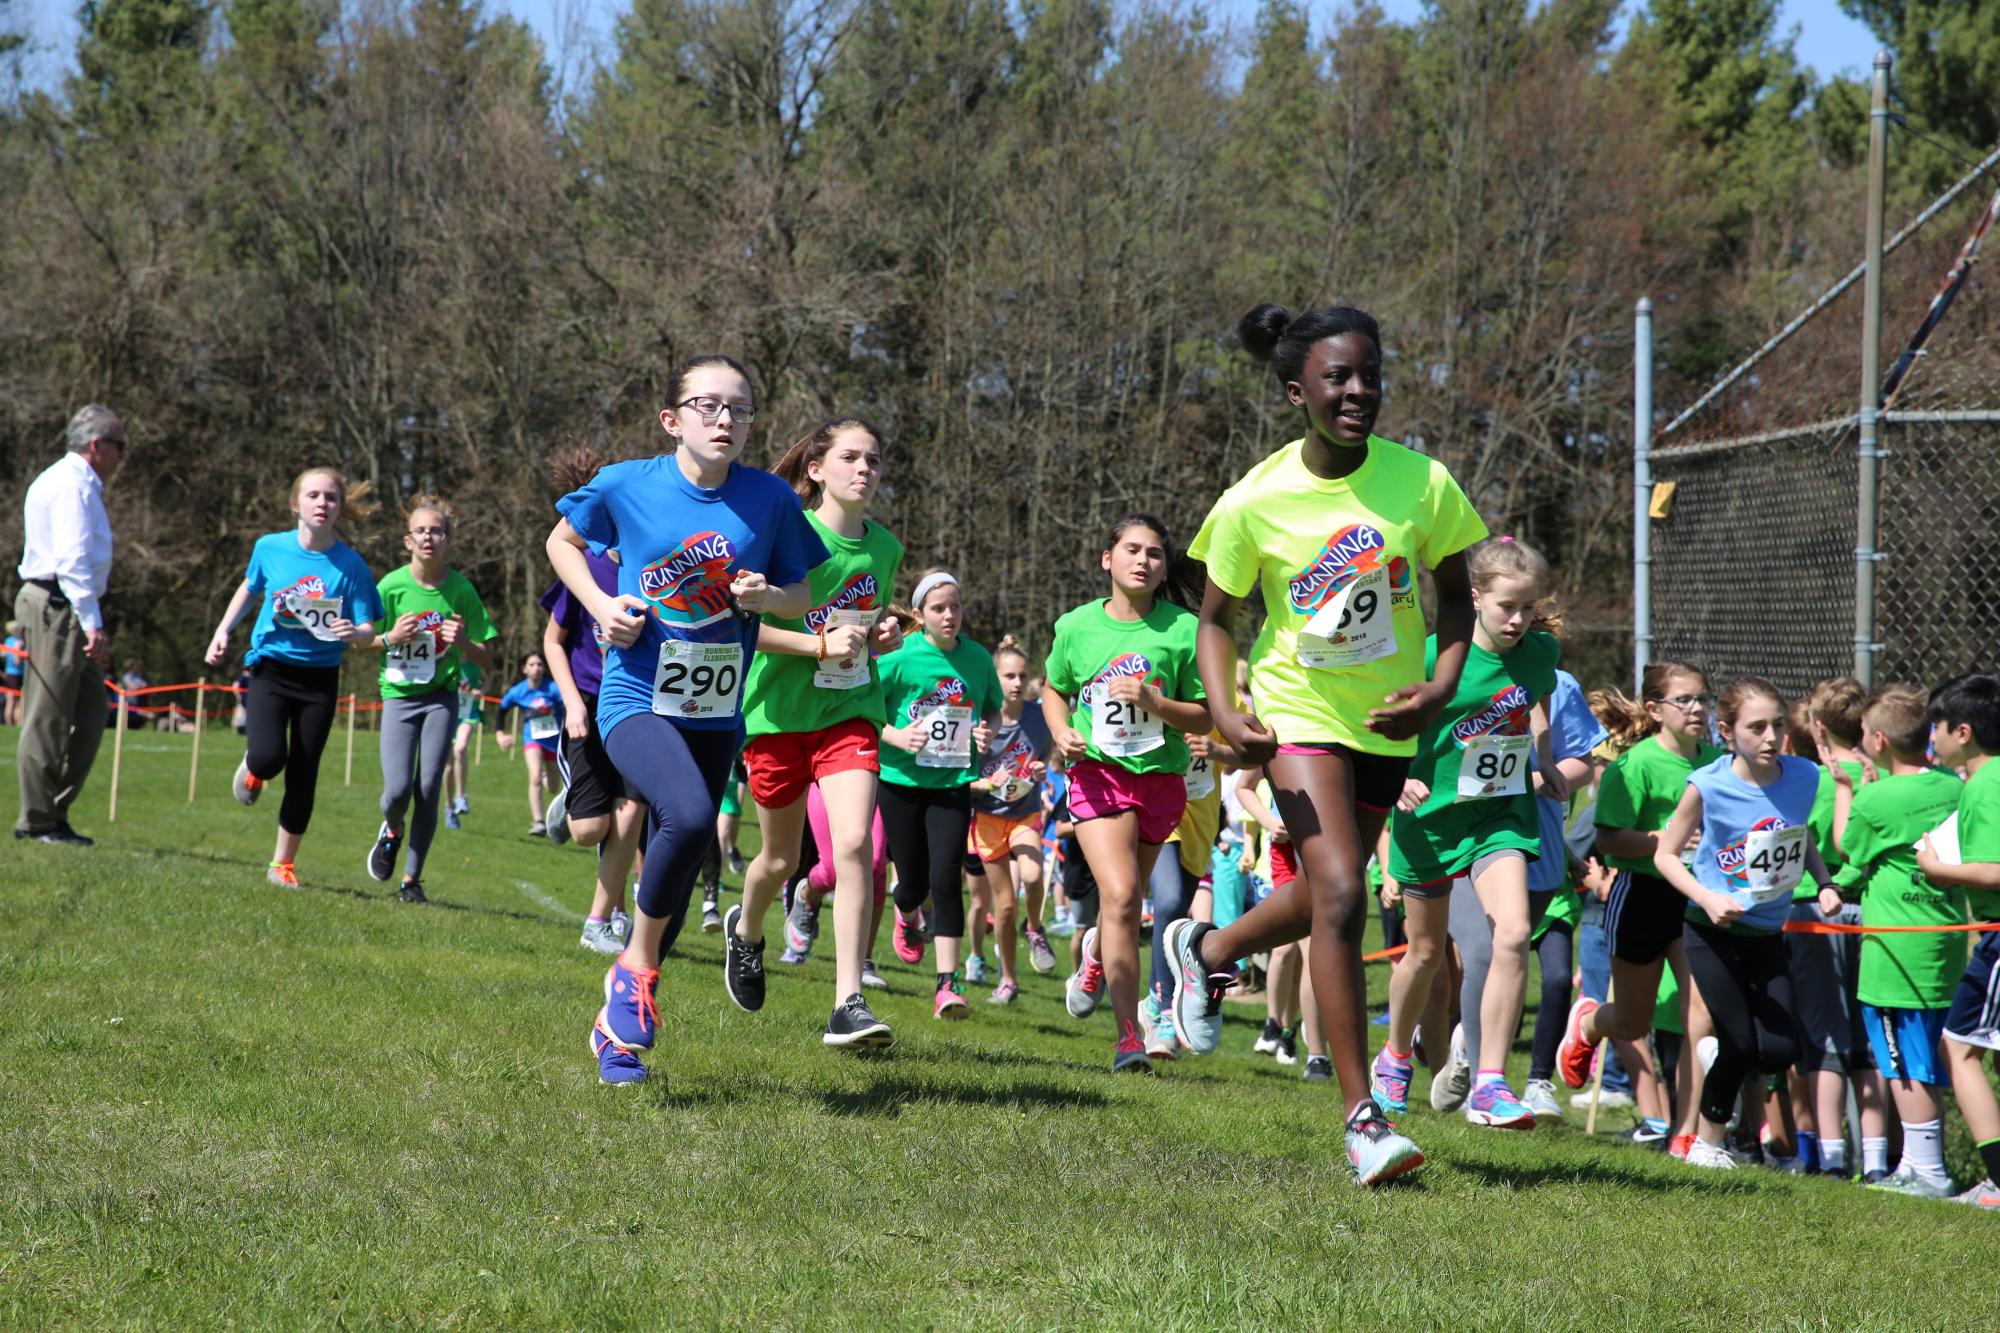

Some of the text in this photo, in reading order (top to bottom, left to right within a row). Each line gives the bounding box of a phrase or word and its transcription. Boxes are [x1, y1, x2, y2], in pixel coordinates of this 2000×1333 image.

[642, 534, 730, 592] RUNNING
[1291, 524, 1378, 602] RUNNING
[659, 662, 737, 697] 290
[1456, 686, 1528, 737] RUNNING
[931, 720, 960, 741] 87
[1476, 753, 1518, 779] 80
[1750, 840, 1802, 873] 494
